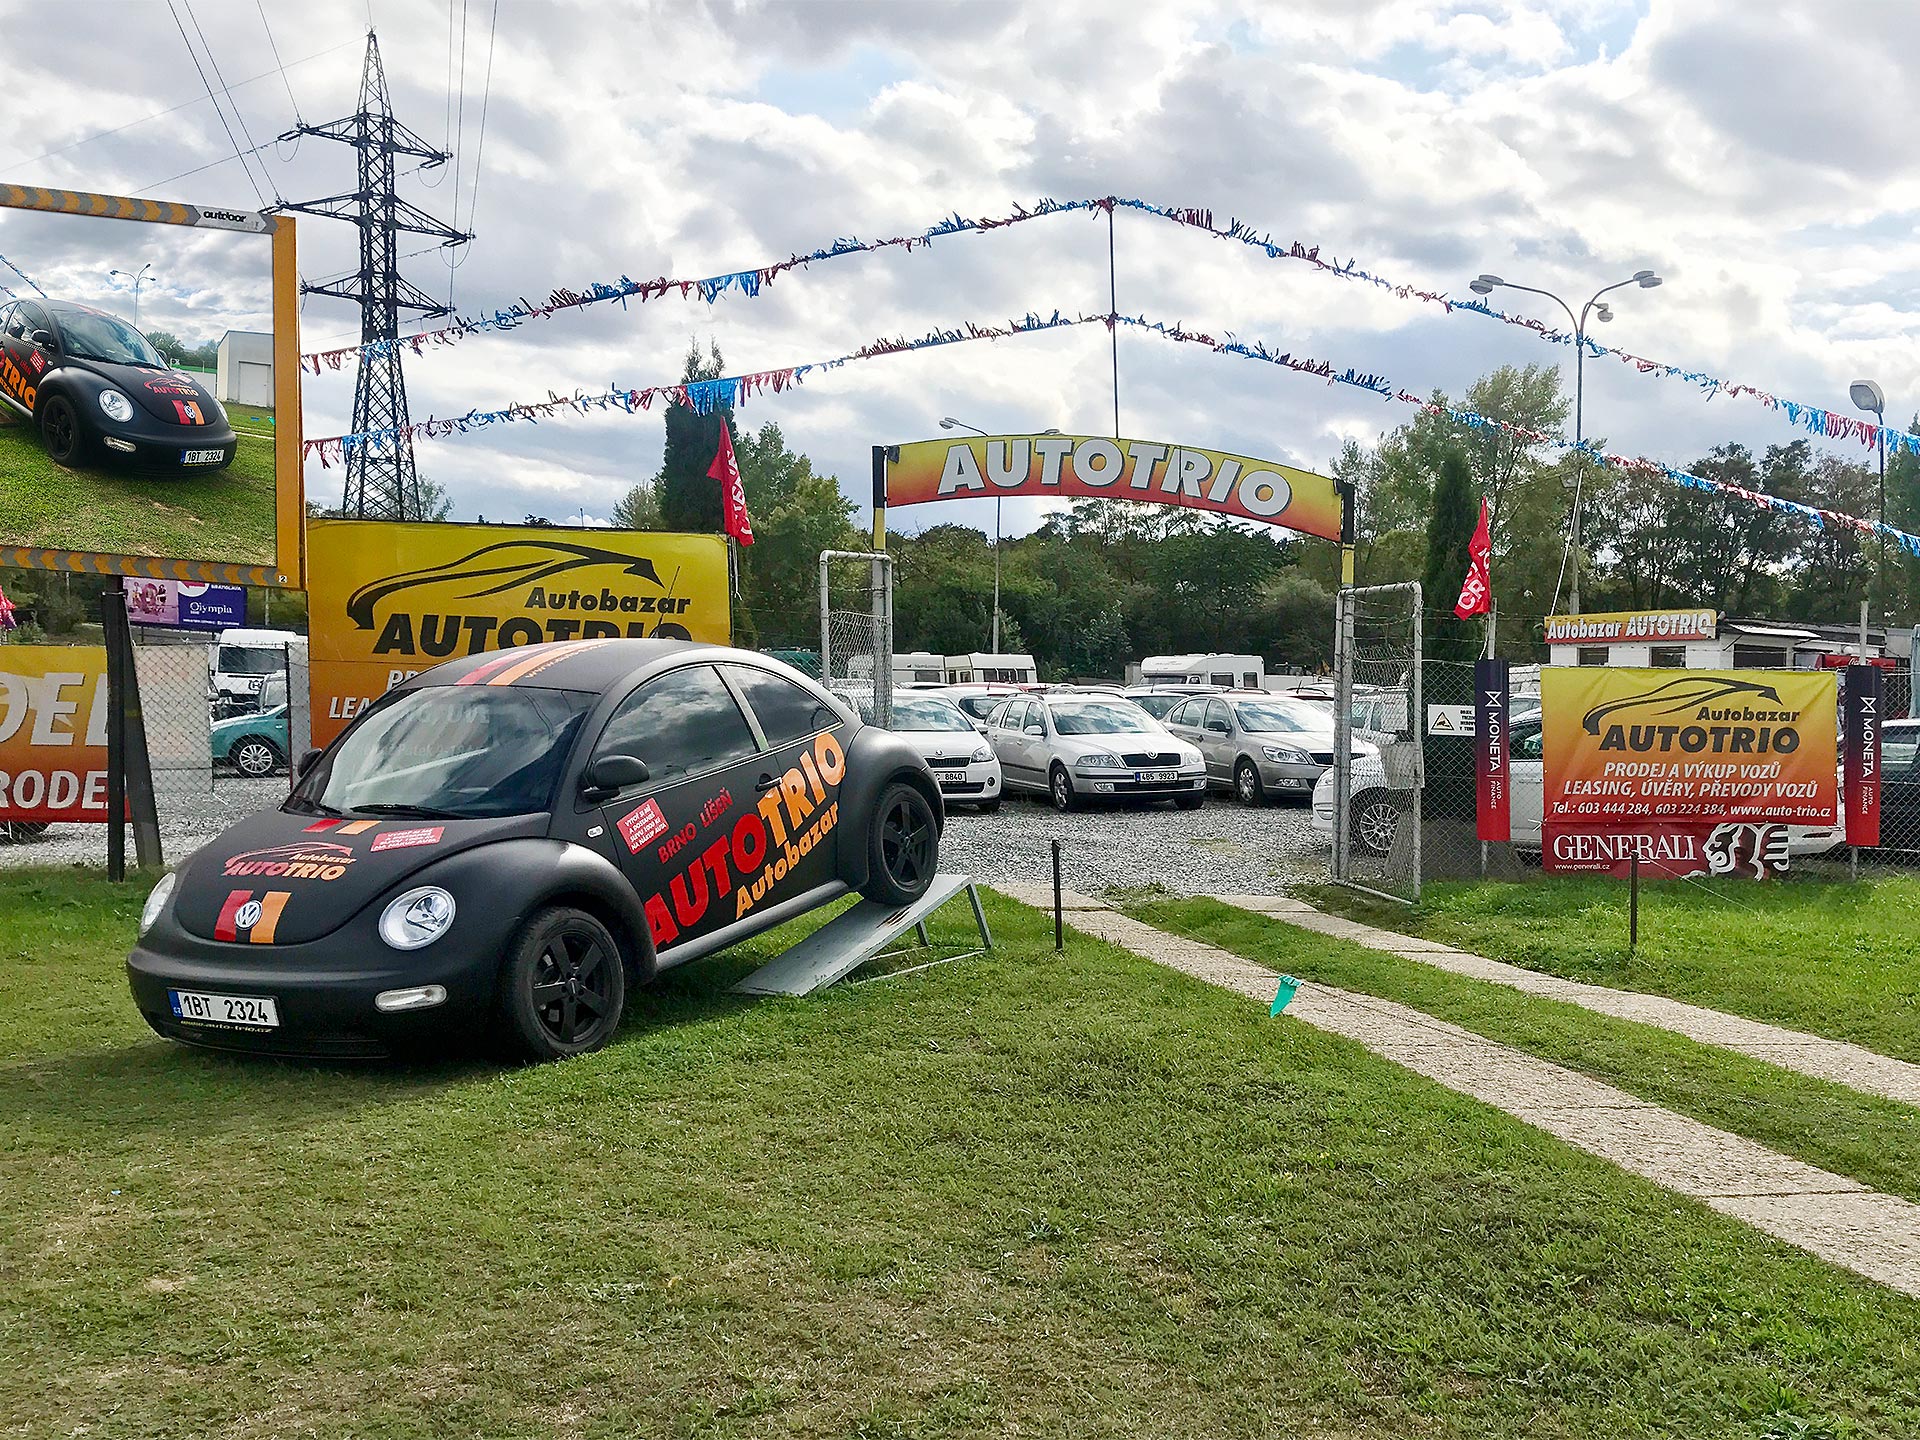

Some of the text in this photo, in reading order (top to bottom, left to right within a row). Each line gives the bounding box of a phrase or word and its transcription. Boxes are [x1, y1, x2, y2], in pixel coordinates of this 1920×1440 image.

[203, 210, 247, 223] outdoor
[187, 450, 221, 461] 1BT 2324
[936, 438, 1292, 517] AUTOTRIO
[525, 586, 692, 614] Autobazar
[1547, 612, 1711, 640] Autobazar AUTOTRIO
[1696, 706, 1800, 722] Autobazar
[1488, 711, 1501, 772] MONETA
[1598, 724, 1800, 754] AUTOTRIO
[1862, 718, 1874, 778] MONETA
[944, 773, 963, 781] 8840
[1603, 760, 1782, 779] PRODEJ A VÝKUP VOZŮ
[1563, 778, 1819, 799] LEASING, ÚVĚRY, PŘEVODY VOZŮ
[1552, 801, 1831, 817] Tel.: 603 444 284, 603 224 384, www.auto-trio.cz
[657, 787, 733, 864] BRNO LÍŠEŇ
[643, 732, 846, 951] AUTOTRIO
[1553, 834, 1698, 861] GENERALI
[221, 861, 346, 881] AUTOTRIO
[289, 853, 357, 864] Autobazar
[736, 801, 839, 921] Autobazar
[183, 995, 211, 1018] 1BT
[223, 999, 269, 1022] 2324
